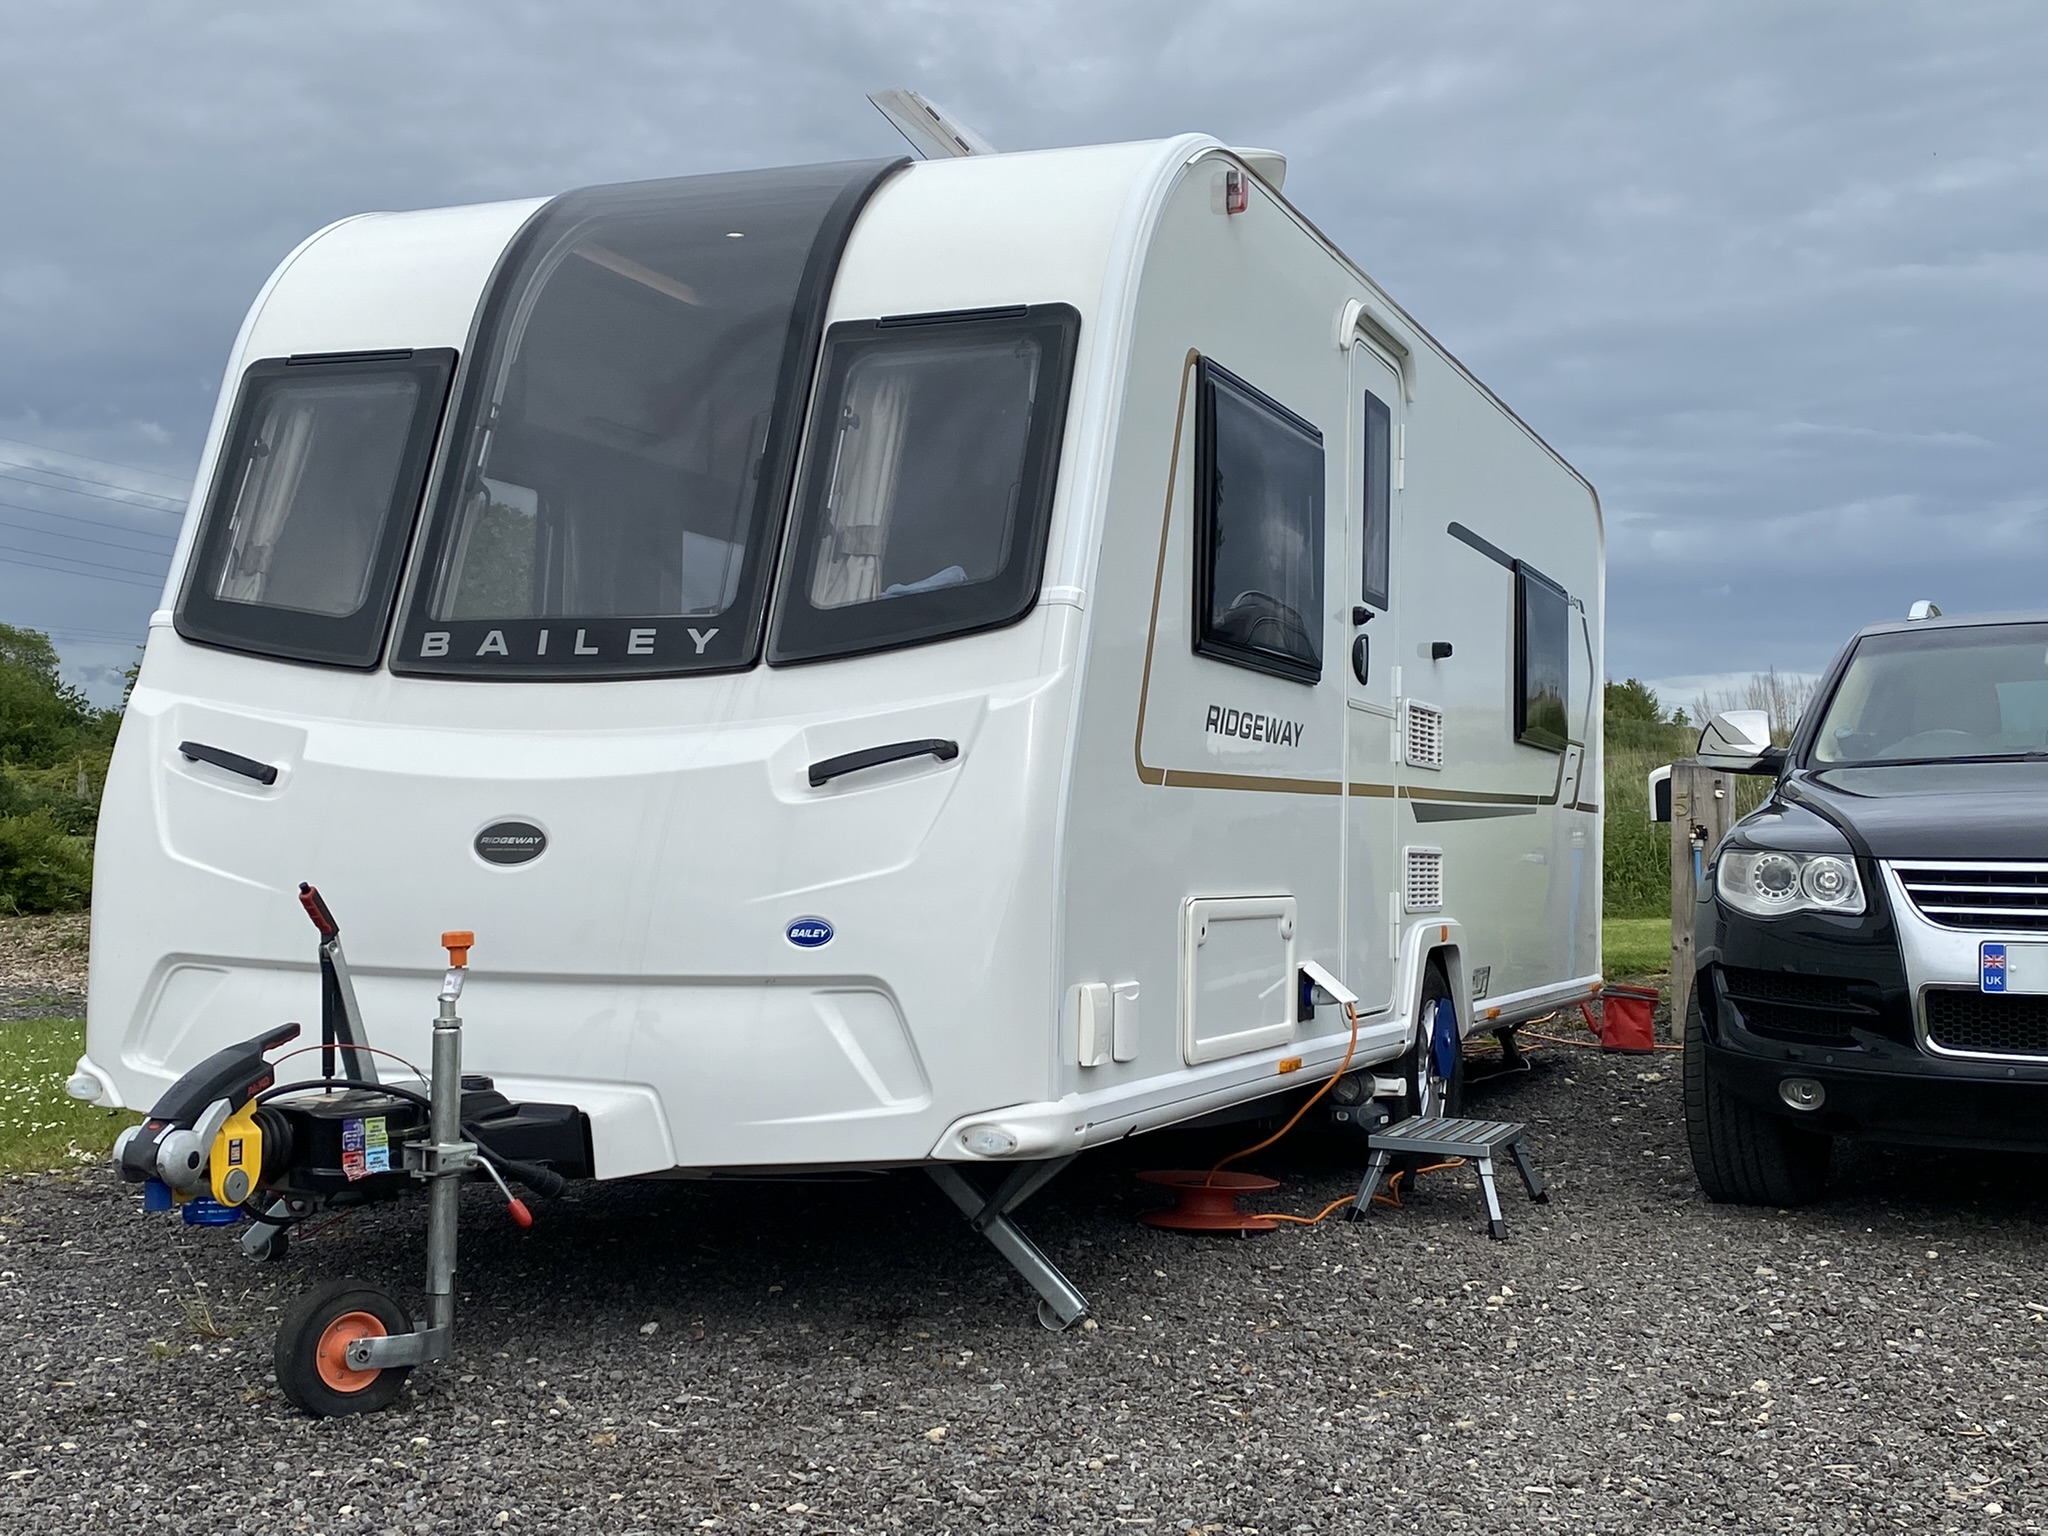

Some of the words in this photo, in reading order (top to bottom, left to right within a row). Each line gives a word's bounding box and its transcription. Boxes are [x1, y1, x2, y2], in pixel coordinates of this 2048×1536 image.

[420, 628, 720, 657] BAILEY
[1205, 704, 1304, 748] RIDGEWAY
[480, 836, 542, 845] RIDGEWAY
[790, 928, 828, 938] BAILEY
[1985, 975, 2002, 985] UK
